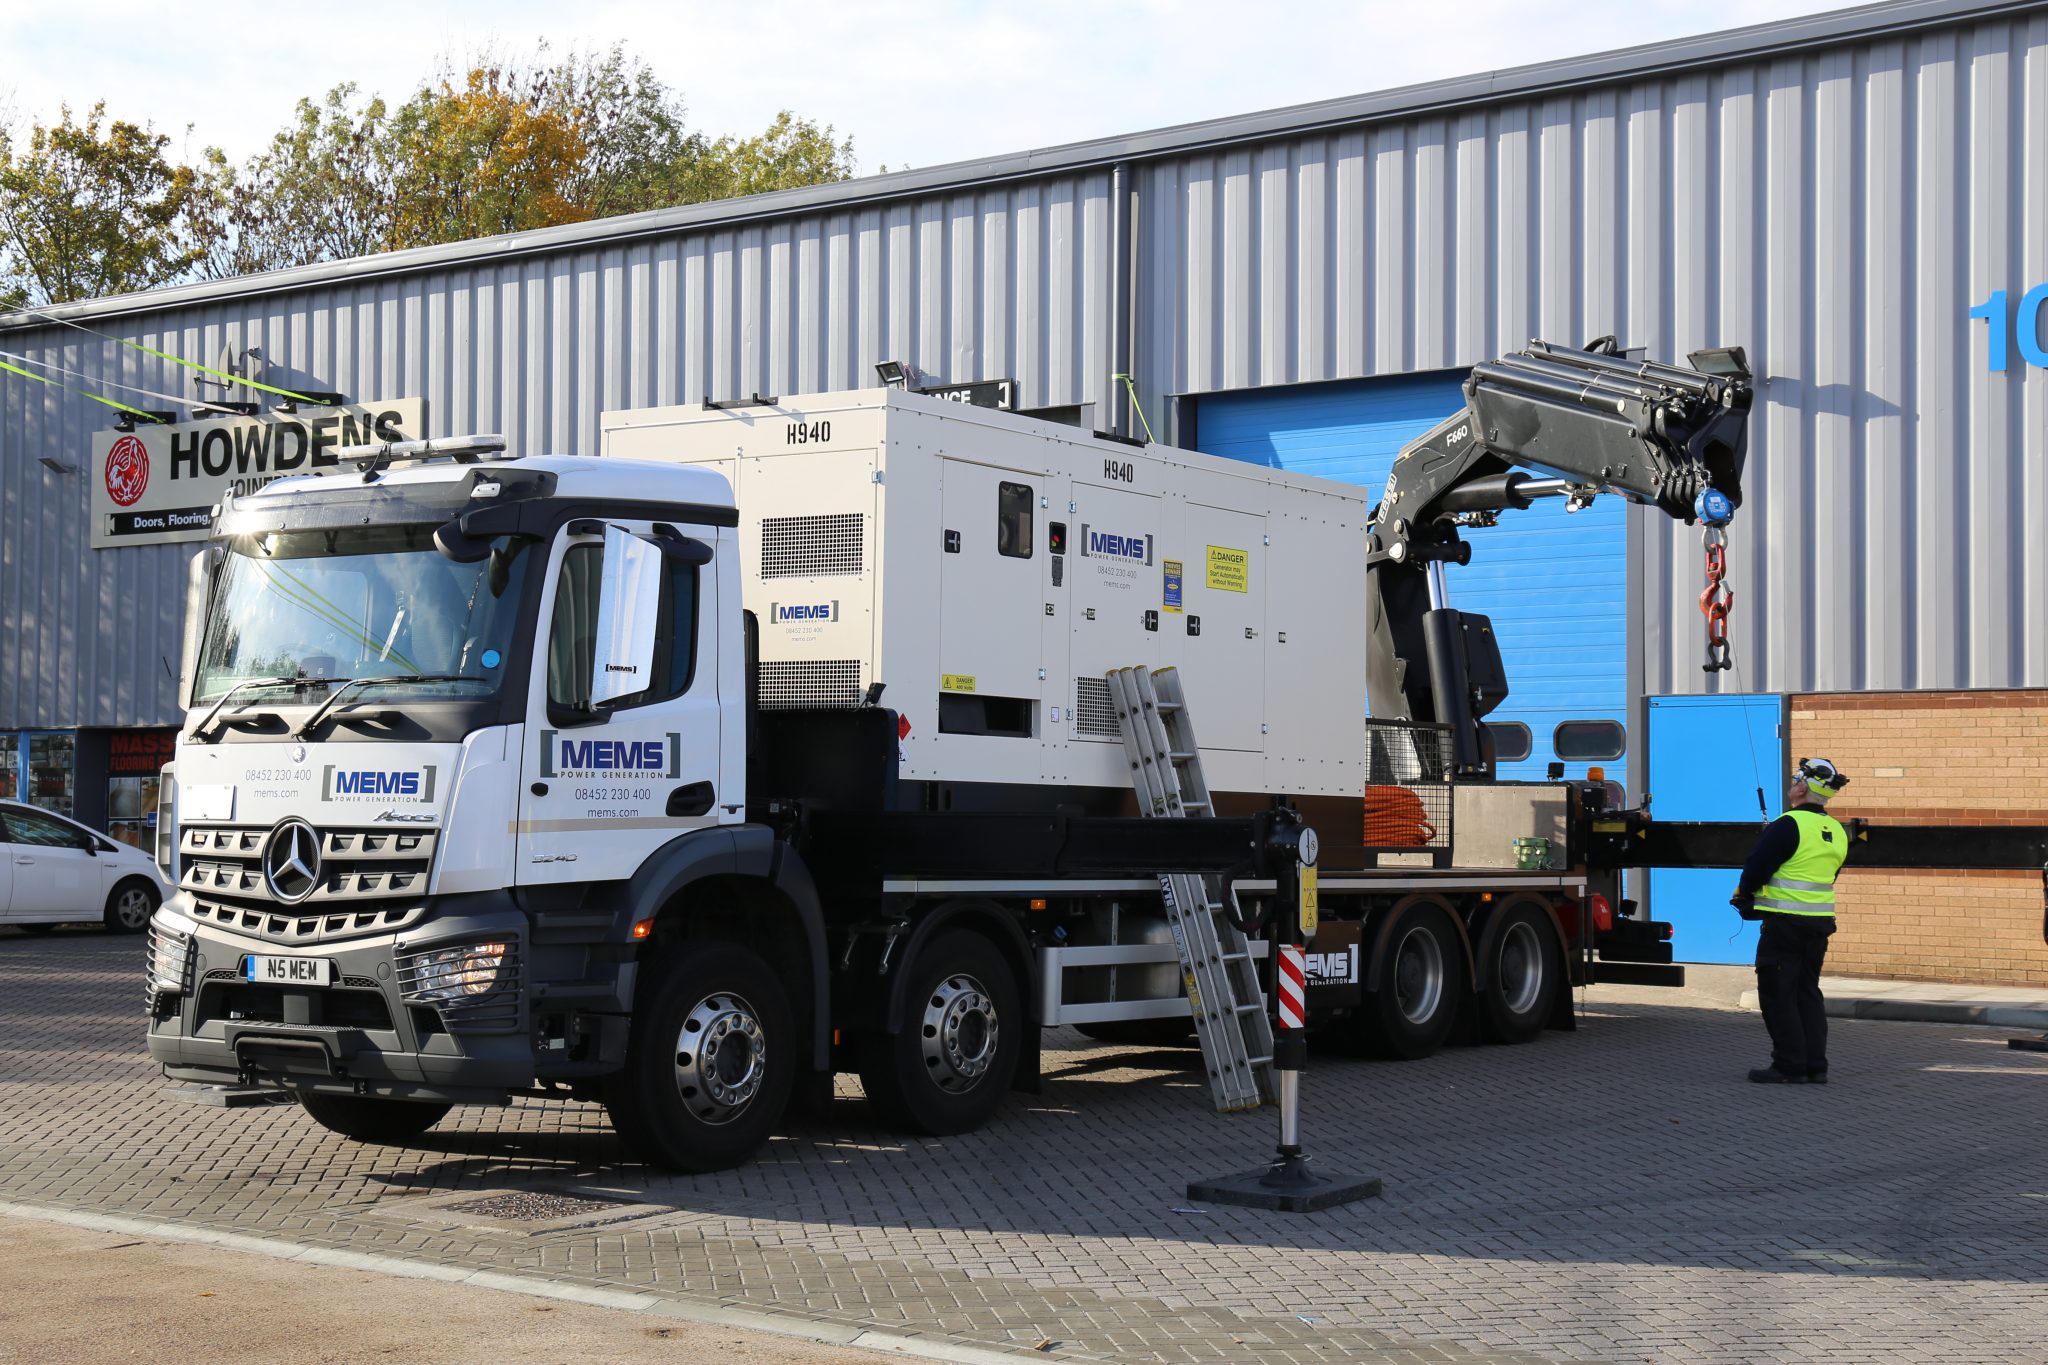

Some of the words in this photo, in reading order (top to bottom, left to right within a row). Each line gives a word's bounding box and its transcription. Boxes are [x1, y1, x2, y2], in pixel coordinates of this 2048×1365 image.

[787, 421, 831, 445] H940
[1446, 425, 1468, 447] F660
[170, 411, 404, 480] HOWDENS
[1104, 459, 1133, 483] H940
[134, 516, 166, 529] Doors,
[168, 512, 212, 526] Flooring,
[1091, 531, 1144, 559] MEMS
[1112, 556, 1144, 566] GENERATION
[1217, 552, 1244, 564] DANGER
[779, 605, 830, 620] MEMS
[111, 756, 155, 771] FLOORING
[561, 740, 664, 769] MEMS
[245, 769, 272, 782] 08452
[274, 769, 292, 782] 230
[294, 769, 312, 781] 400
[336, 771, 420, 794] MEMS
[561, 771, 596, 779] POWER
[602, 771, 663, 779] GENERATION
[253, 788, 299, 799] mems.com
[575, 788, 608, 801] 08452
[611, 788, 630, 800] 230
[632, 788, 651, 800] 400
[587, 808, 639, 818] mems.com
[1160, 877, 1175, 907] LYTE
[268, 958, 286, 979] N5
[289, 959, 317, 981] MEM
[1305, 952, 1348, 979] EMS
